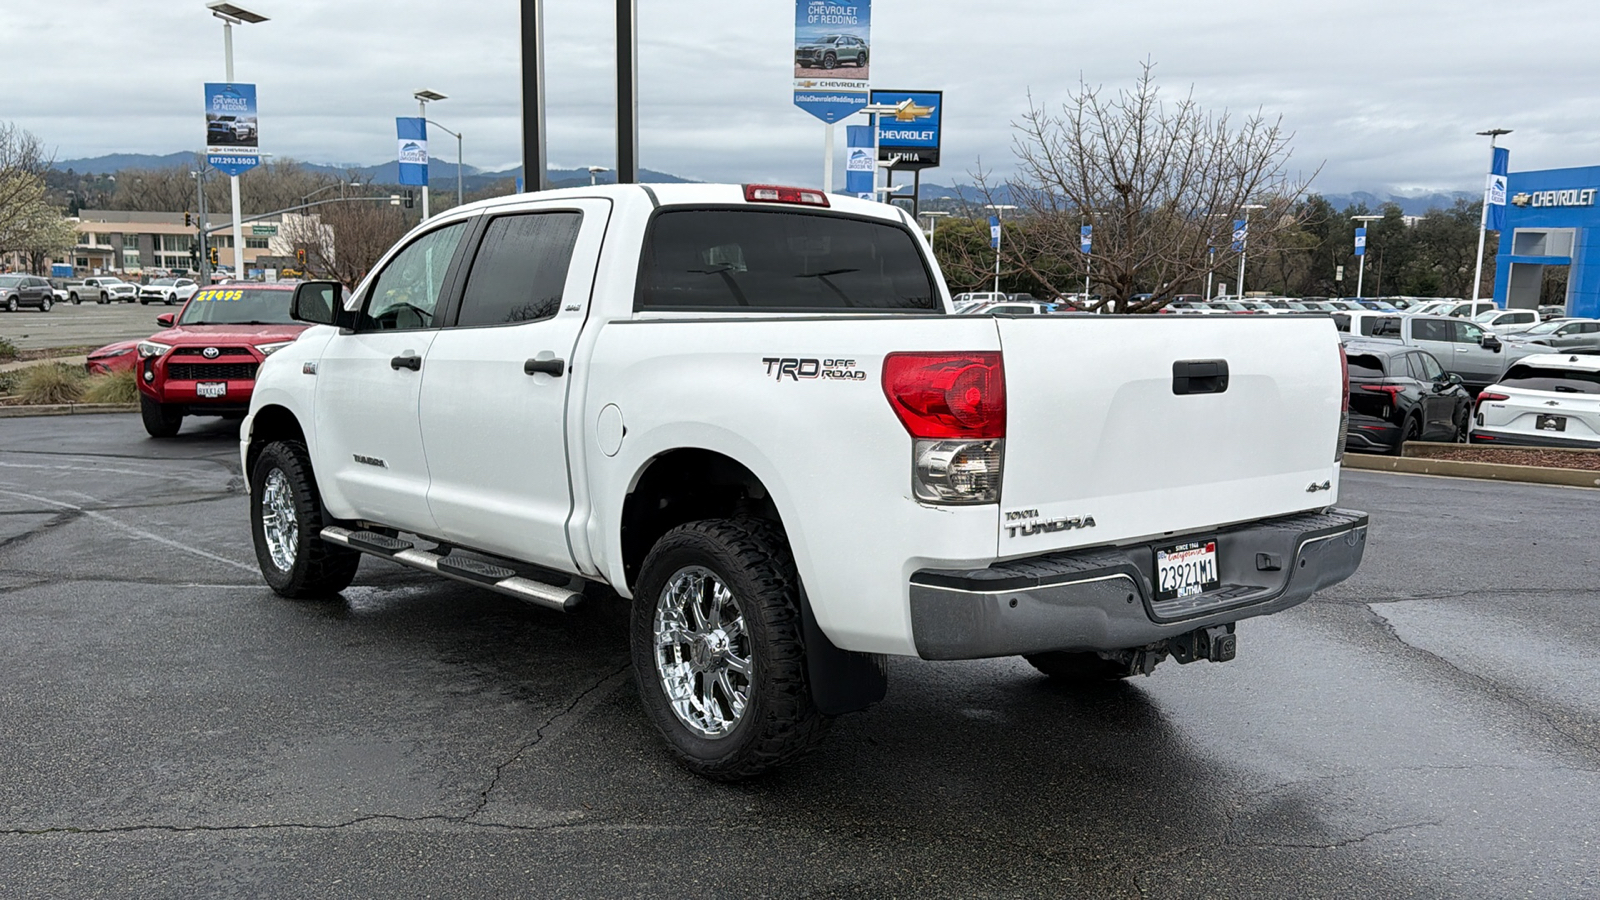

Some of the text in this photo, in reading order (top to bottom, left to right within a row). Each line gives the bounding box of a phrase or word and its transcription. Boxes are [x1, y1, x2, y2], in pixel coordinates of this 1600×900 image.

[808, 6, 858, 15] CHEVROLET
[807, 15, 858, 25] OF REDDING
[795, 95, 867, 104] LithiaChevroletRedding.com
[210, 157, 256, 165] 877.293.5503
[888, 152, 920, 162] LITHIA
[1532, 189, 1596, 206] CHEVROLET
[196, 290, 244, 301] 27495
[762, 357, 857, 382] TRD OFF
[821, 369, 867, 381] ROAD
[1004, 508, 1040, 521] TOYOTA
[1004, 513, 1096, 538] TUNDRA
[1175, 543, 1189, 551] SINCE
[1168, 549, 1206, 562] California
[1161, 559, 1215, 592] 23921M1
